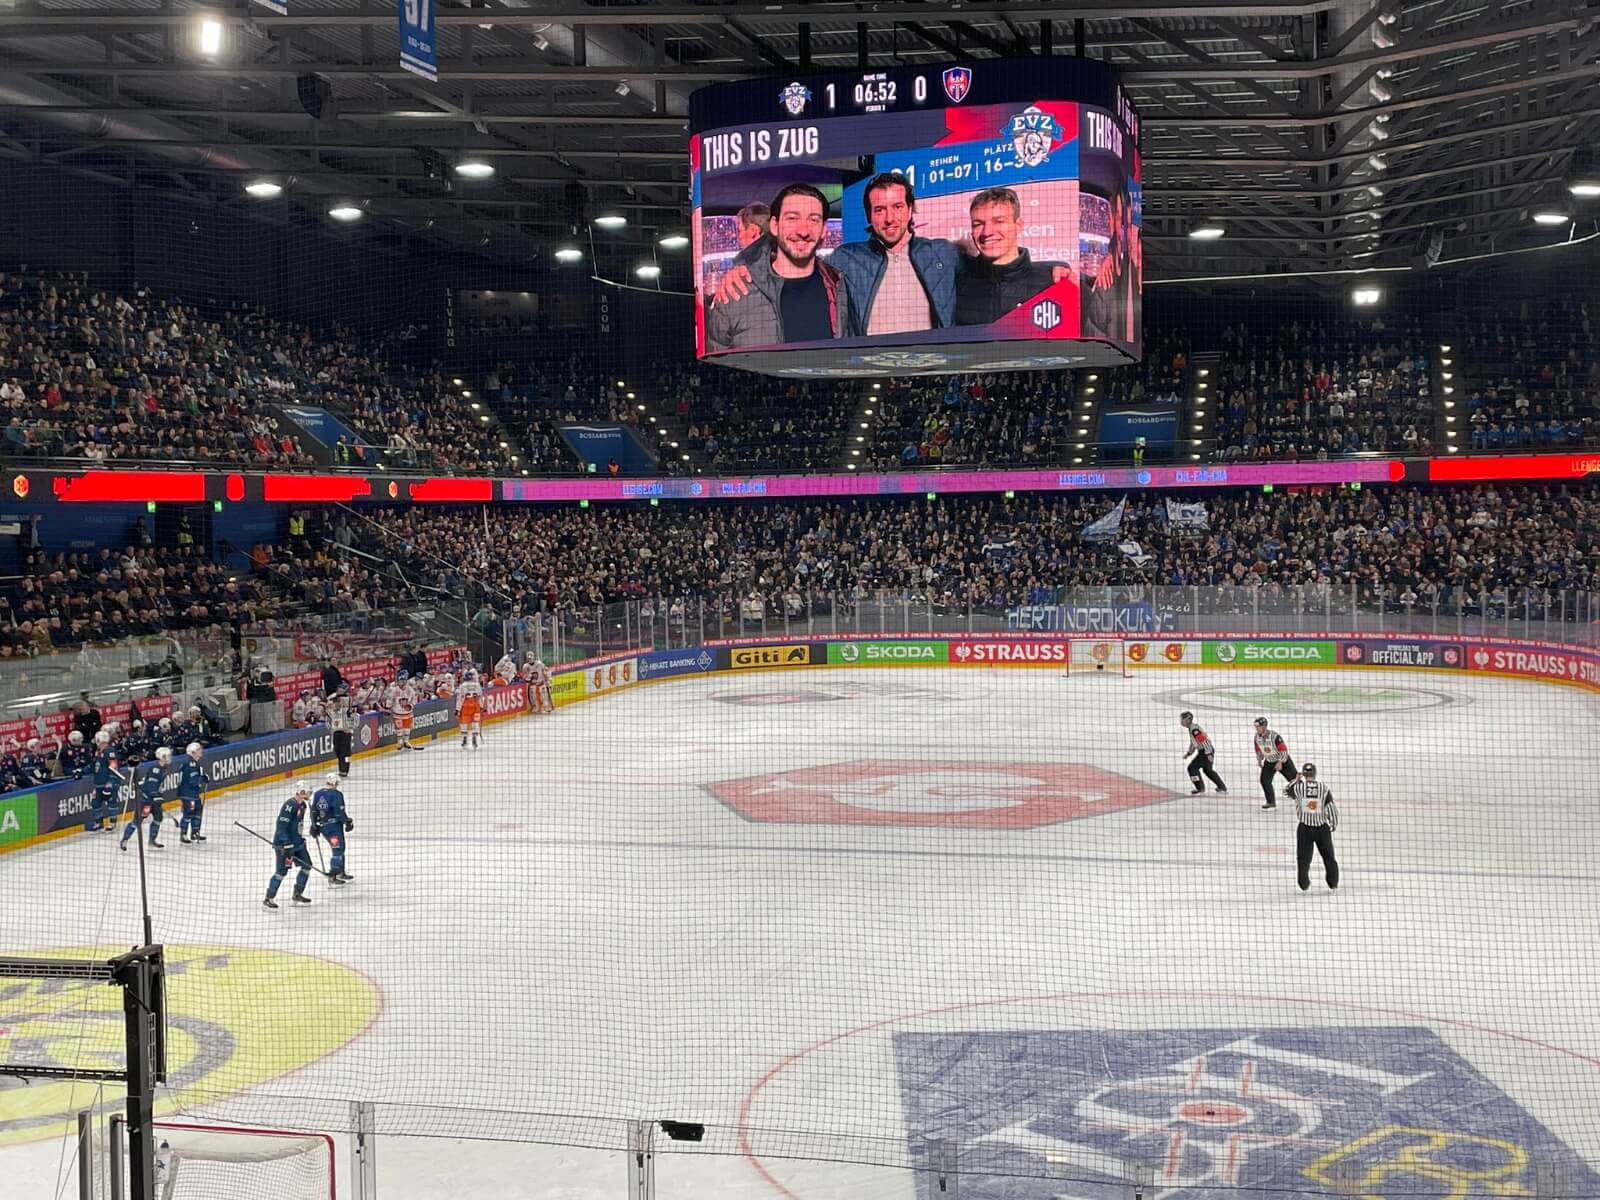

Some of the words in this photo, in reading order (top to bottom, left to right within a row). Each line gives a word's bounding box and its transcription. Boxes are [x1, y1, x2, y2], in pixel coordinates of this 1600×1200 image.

[784, 86, 806, 97] EVZ
[826, 83, 836, 108] 1
[855, 81, 897, 103] 06:52
[915, 75, 927, 101] 0
[1012, 114, 1053, 132] EVZ
[703, 132, 743, 172] THIS
[750, 129, 771, 162] IS
[778, 126, 819, 158] ZUG
[983, 143, 1014, 156] PLÄTZ
[1033, 300, 1061, 329] CHL
[735, 650, 779, 665] Giti
[866, 644, 936, 659] ŠKODA
[973, 644, 1065, 661] STRAUSS
[1244, 644, 1322, 660] ŠKODA
[1372, 650, 1415, 664] OFFICIAL
[1416, 652, 1434, 665] APP
[669, 657, 696, 669] BANKING
[1494, 650, 1566, 676] STRAUSS
[212, 745, 276, 782] CHAMPIONS
[278, 738, 318, 765] HOCKEY
